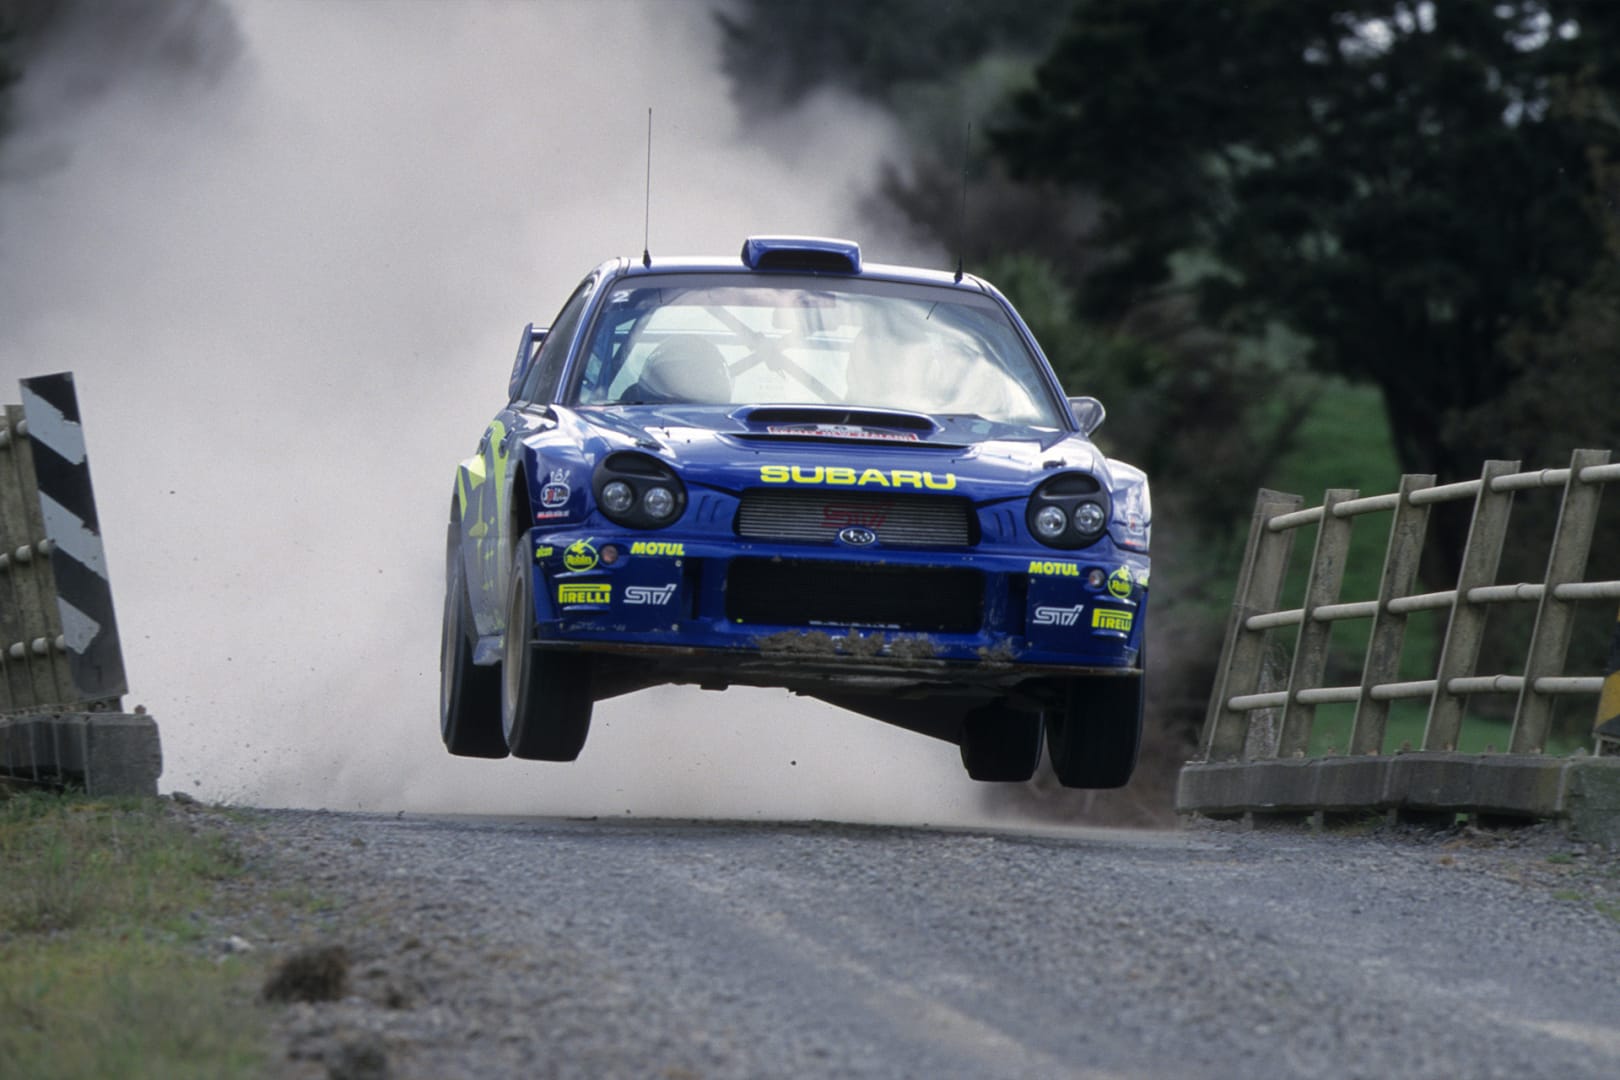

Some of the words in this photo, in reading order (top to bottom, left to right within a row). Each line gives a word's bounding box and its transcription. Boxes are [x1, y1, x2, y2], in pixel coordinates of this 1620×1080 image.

[611, 289, 630, 303] 2
[760, 465, 957, 490] SUBARU
[630, 541, 685, 557] MOTUL
[1028, 561, 1080, 577] MOTUL
[557, 583, 612, 604] PIRELLI
